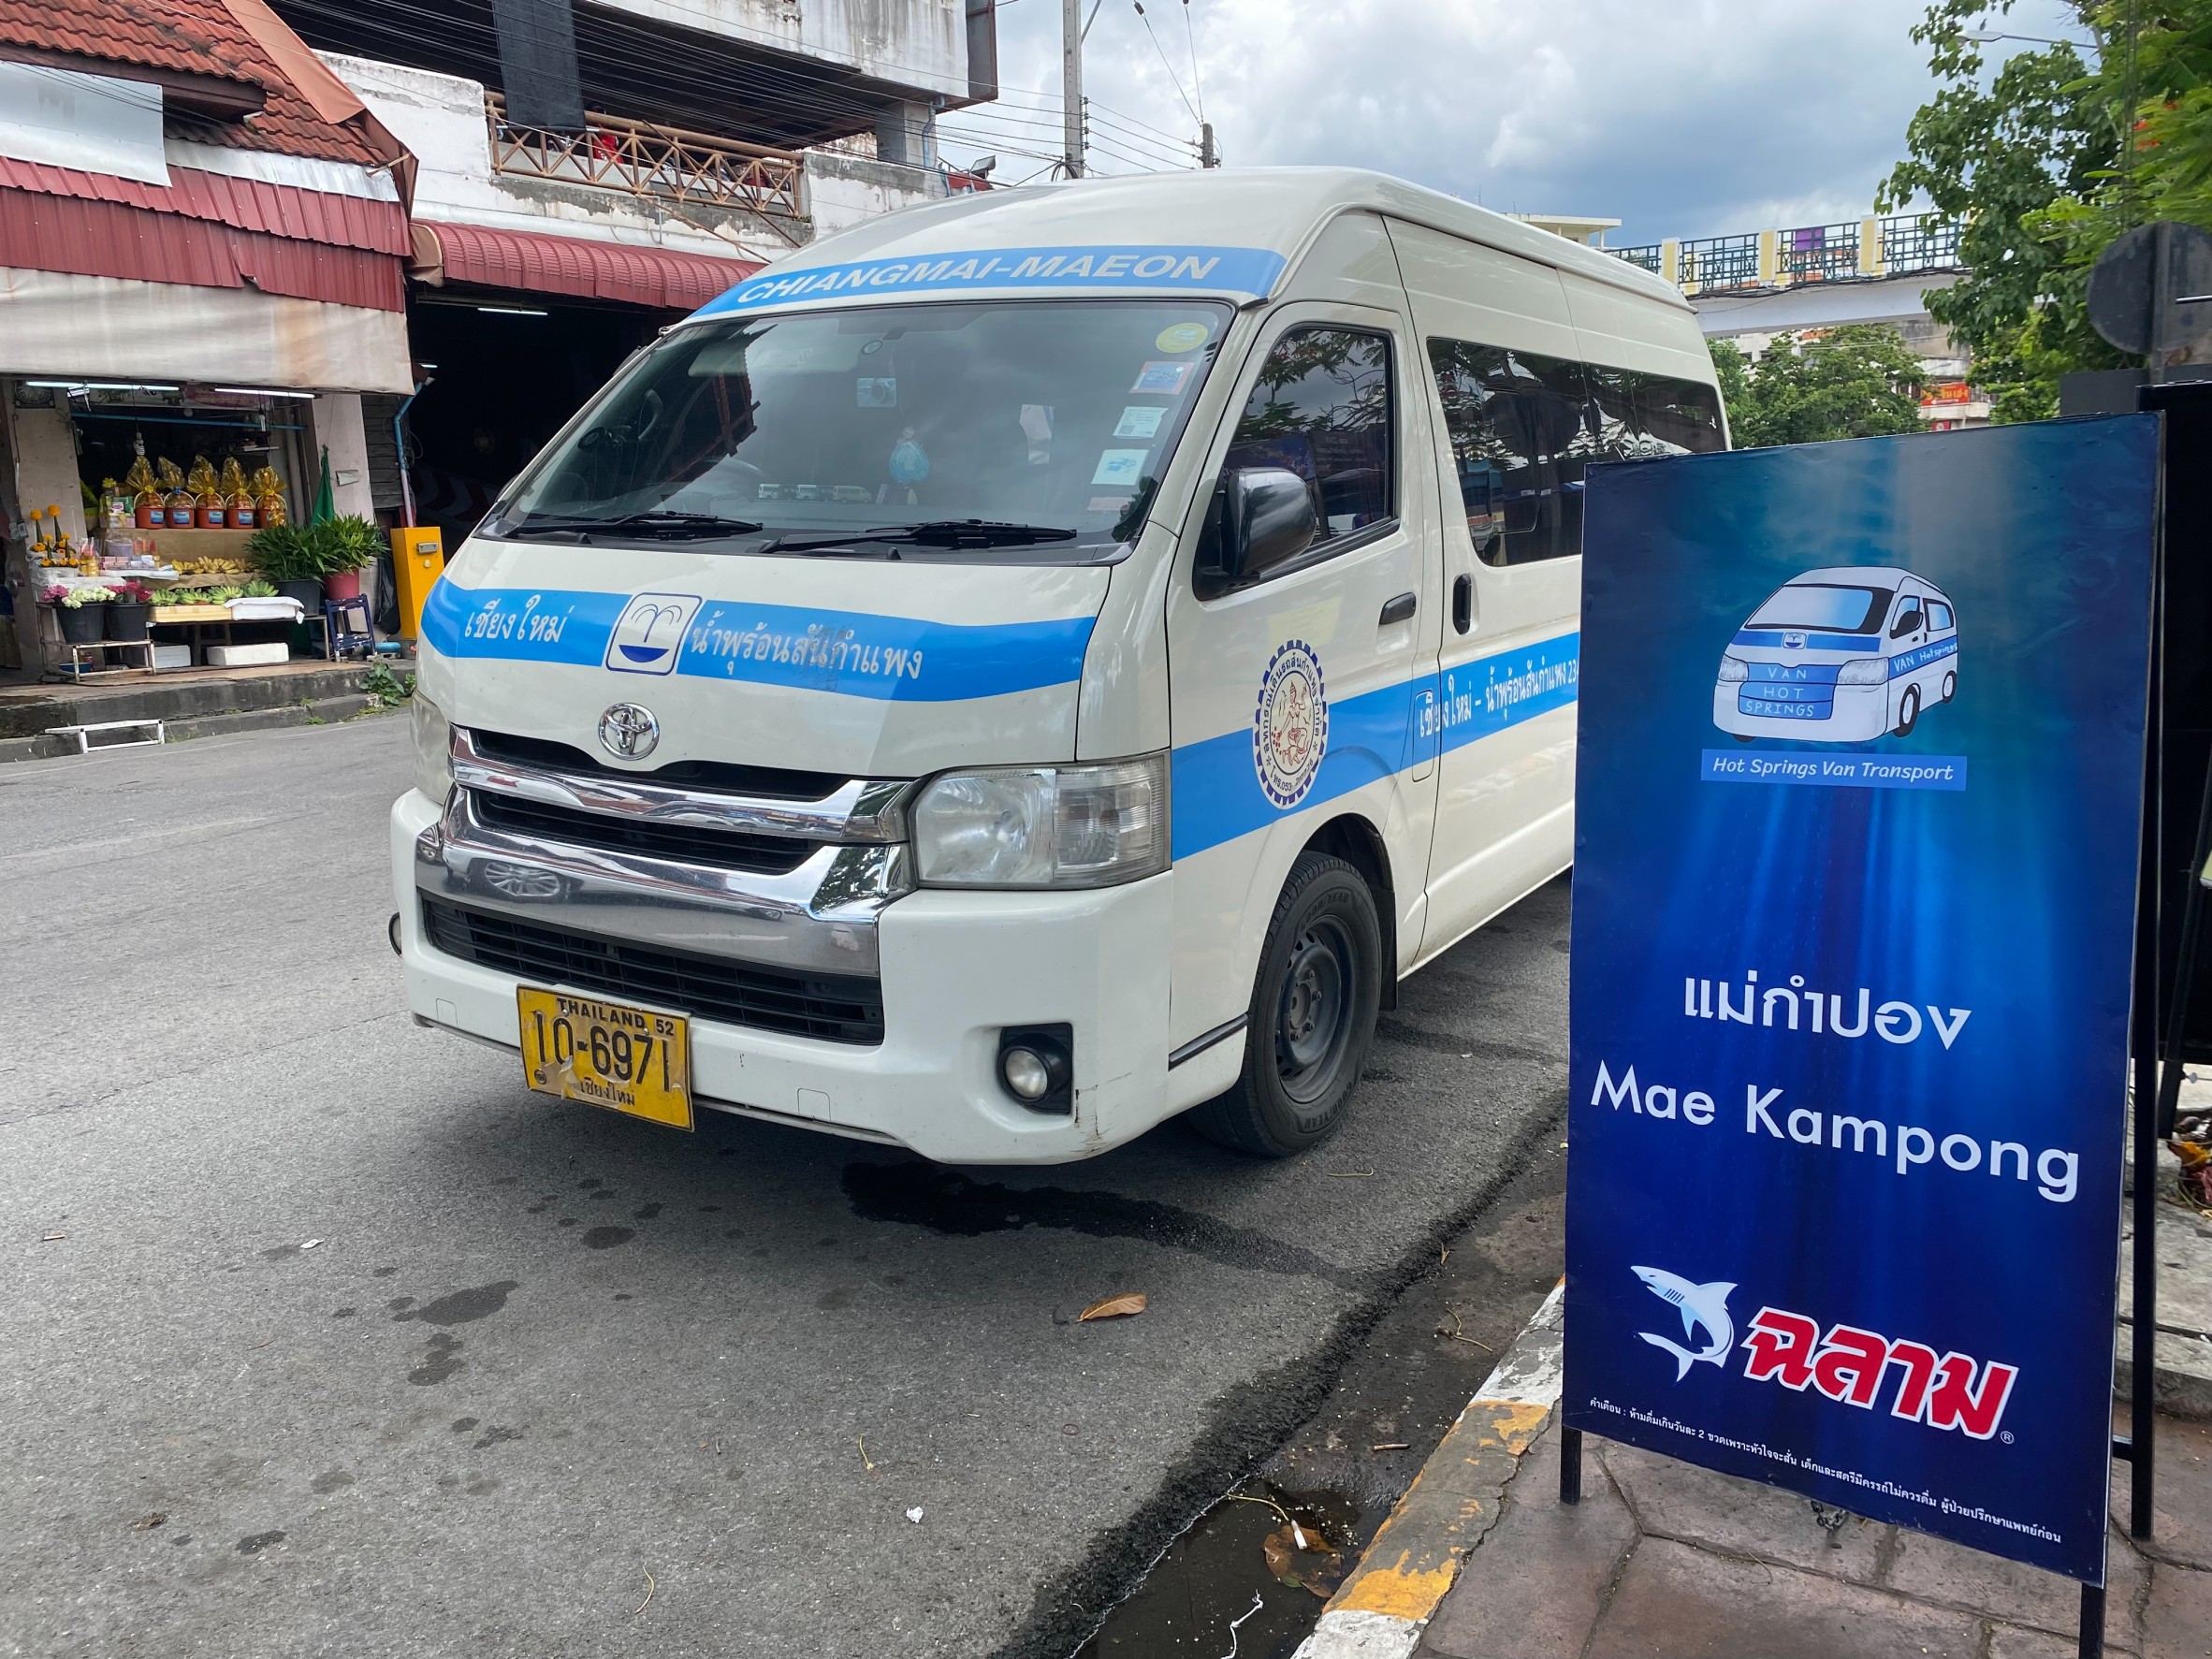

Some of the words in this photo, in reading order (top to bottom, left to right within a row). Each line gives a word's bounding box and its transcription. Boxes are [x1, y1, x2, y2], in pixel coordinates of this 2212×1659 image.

[736, 255, 1221, 304] CHIANGMAI-MAEON
[464, 593, 575, 644] เชียงใหม่
[691, 610, 924, 680] น้ำพุร้อนสันกำแพง
[1893, 656, 1915, 673] VAN
[1485, 655, 1566, 721] น้ำพุร้อนสันกำแพง
[1764, 687, 1804, 699] HOT
[1768, 667, 1807, 680] VAN
[1745, 701, 1814, 717] SPRINGS
[1712, 757, 1745, 773] Hot
[1750, 758, 1817, 777] Springs
[1822, 762, 1855, 777] Van
[1861, 762, 1954, 782] Transport
[557, 997, 646, 1029] THAILAND
[656, 1019, 675, 1037] 52
[1684, 969, 1972, 1051] แม่กำปอง
[1591, 1059, 1716, 1126] Mae
[1746, 1084, 2080, 1202] Kampong
[1740, 1305, 2019, 1442] ฉลาม
[1590, 1396, 1622, 1415] คำเตือน
[1629, 1407, 1696, 1436] ห้ามดื่มเกินวันละ
[1697, 1429, 1705, 1439] 2
[1941, 1497, 2062, 1544] ผู้ป่วยปรึกษาแพทย์ก่อน
